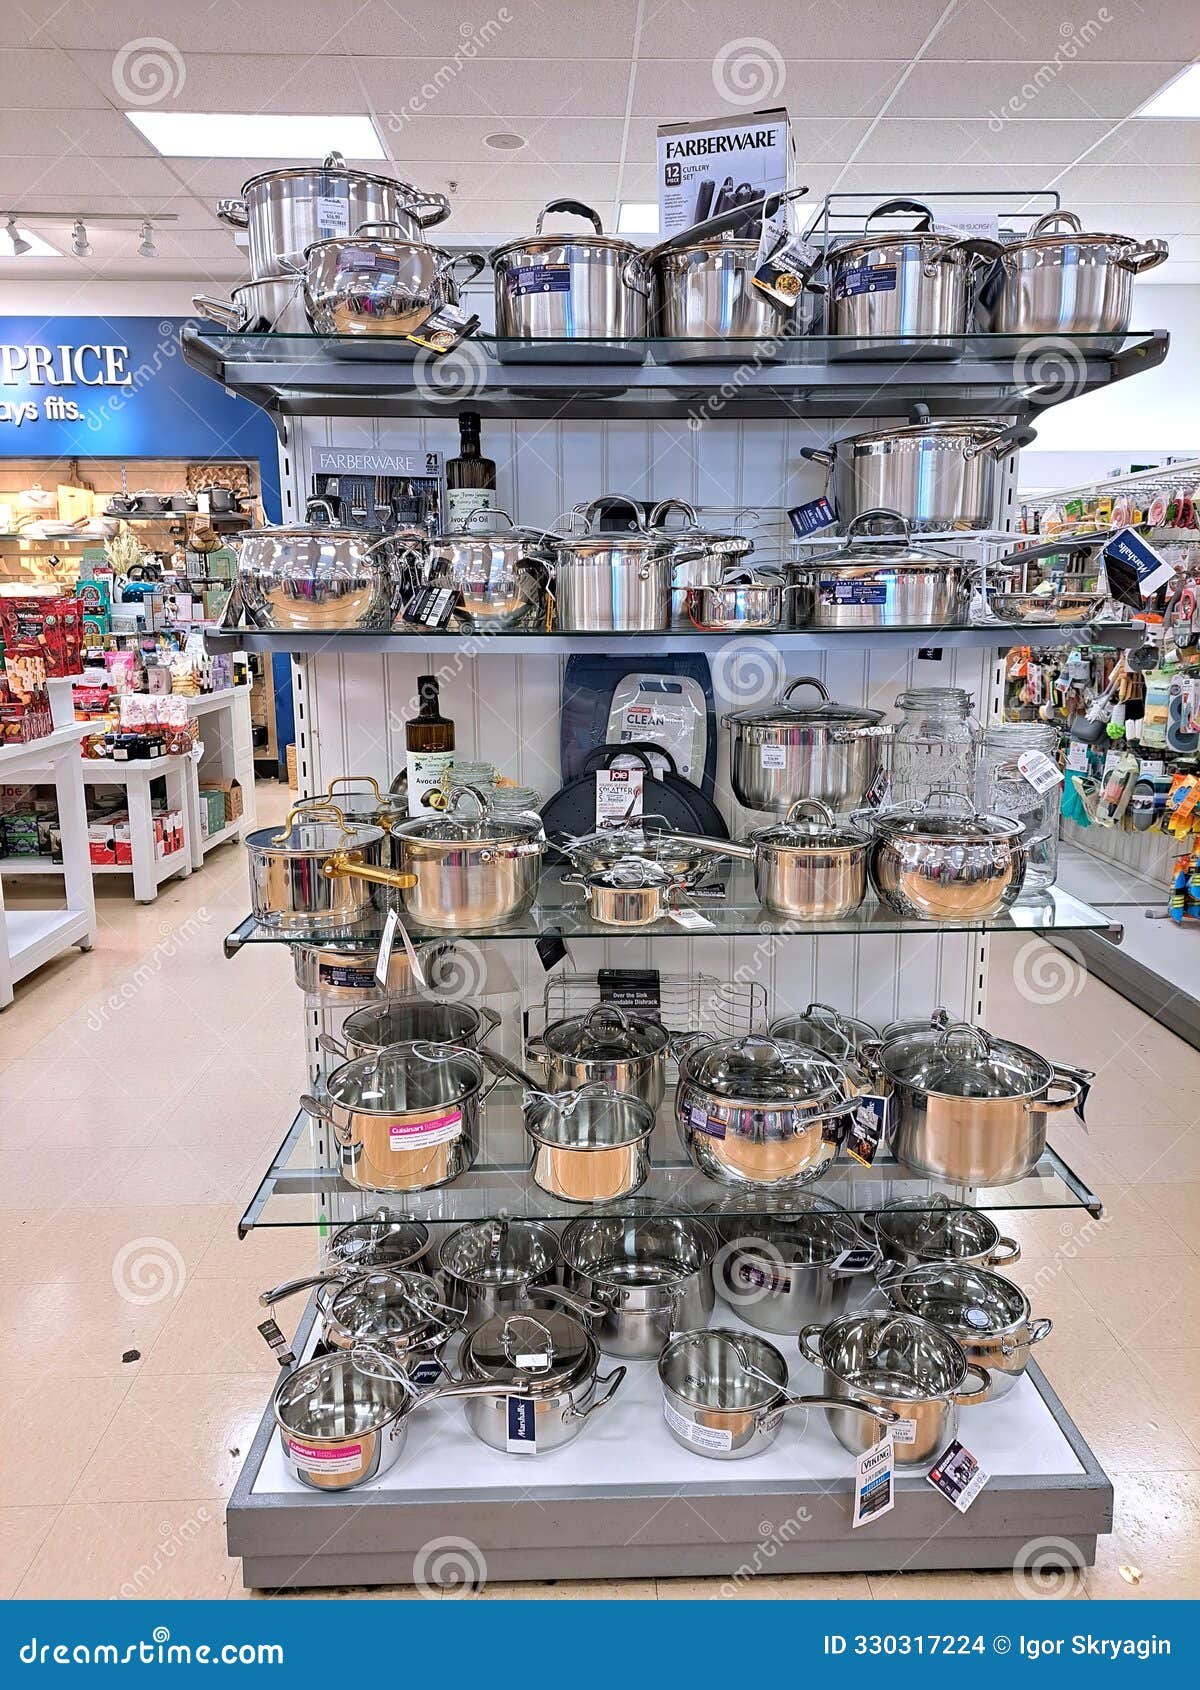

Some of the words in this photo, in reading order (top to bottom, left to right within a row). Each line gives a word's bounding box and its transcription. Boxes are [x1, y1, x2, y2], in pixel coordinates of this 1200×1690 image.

[666, 130, 776, 159] FARBERWARE
[666, 165, 680, 178] 12
[682, 164, 710, 174] CUTLERY
[682, 173, 694, 181] SET
[0, 344, 133, 387] PRICE
[44, 395, 86, 421] fits.
[320, 453, 416, 471] FARBERWARE
[426, 453, 438, 464] 21
[1118, 542, 1151, 574] Marshalls
[391, 1125, 424, 1134] Cuisinart
[517, 1403, 526, 1438] Marshalls
[291, 1442, 316, 1456] Cuisinart
[862, 1449, 890, 1470] VIKING
